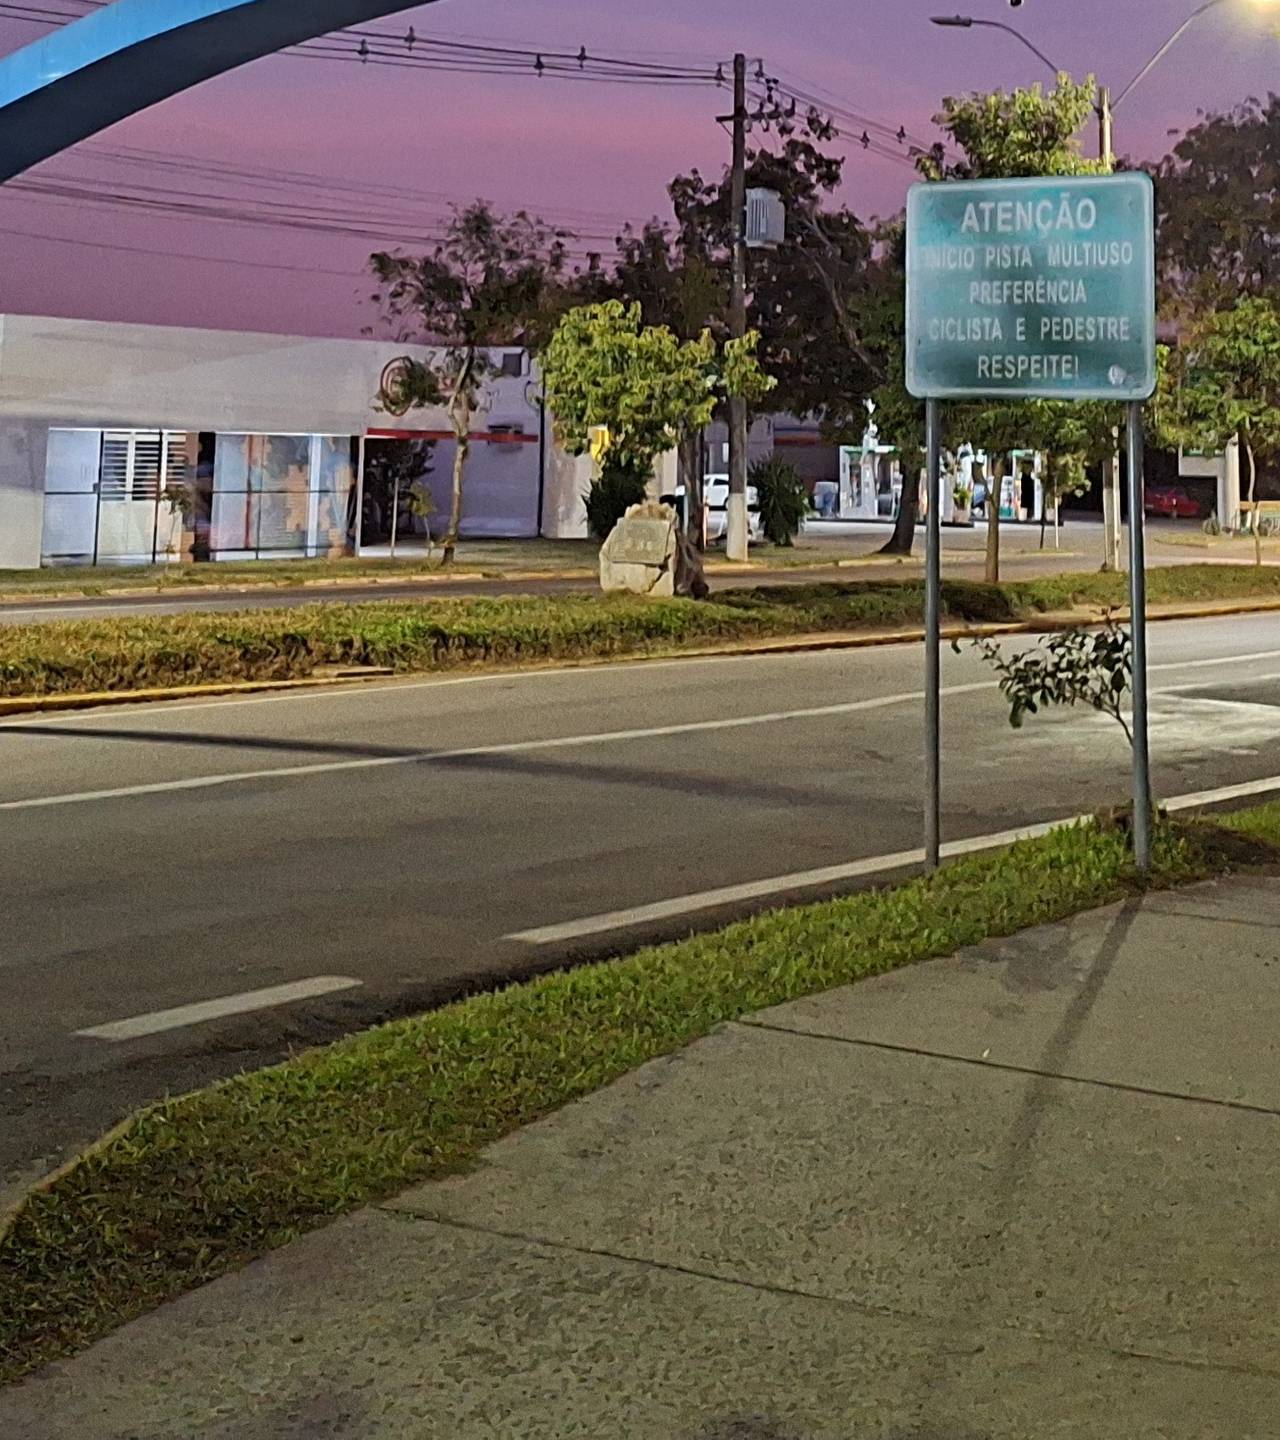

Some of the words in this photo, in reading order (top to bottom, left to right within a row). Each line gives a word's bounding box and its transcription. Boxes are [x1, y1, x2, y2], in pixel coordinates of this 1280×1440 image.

[961, 193, 1096, 237] ATENÇÃO
[984, 244, 1033, 268] PISTA
[1048, 241, 1133, 267] MULTIUSO
[970, 275, 1086, 304] PREFERÊNCIA
[929, 318, 1002, 341] CICLISTA
[1015, 318, 1026, 340] E
[1041, 317, 1130, 341] PEDESTRE
